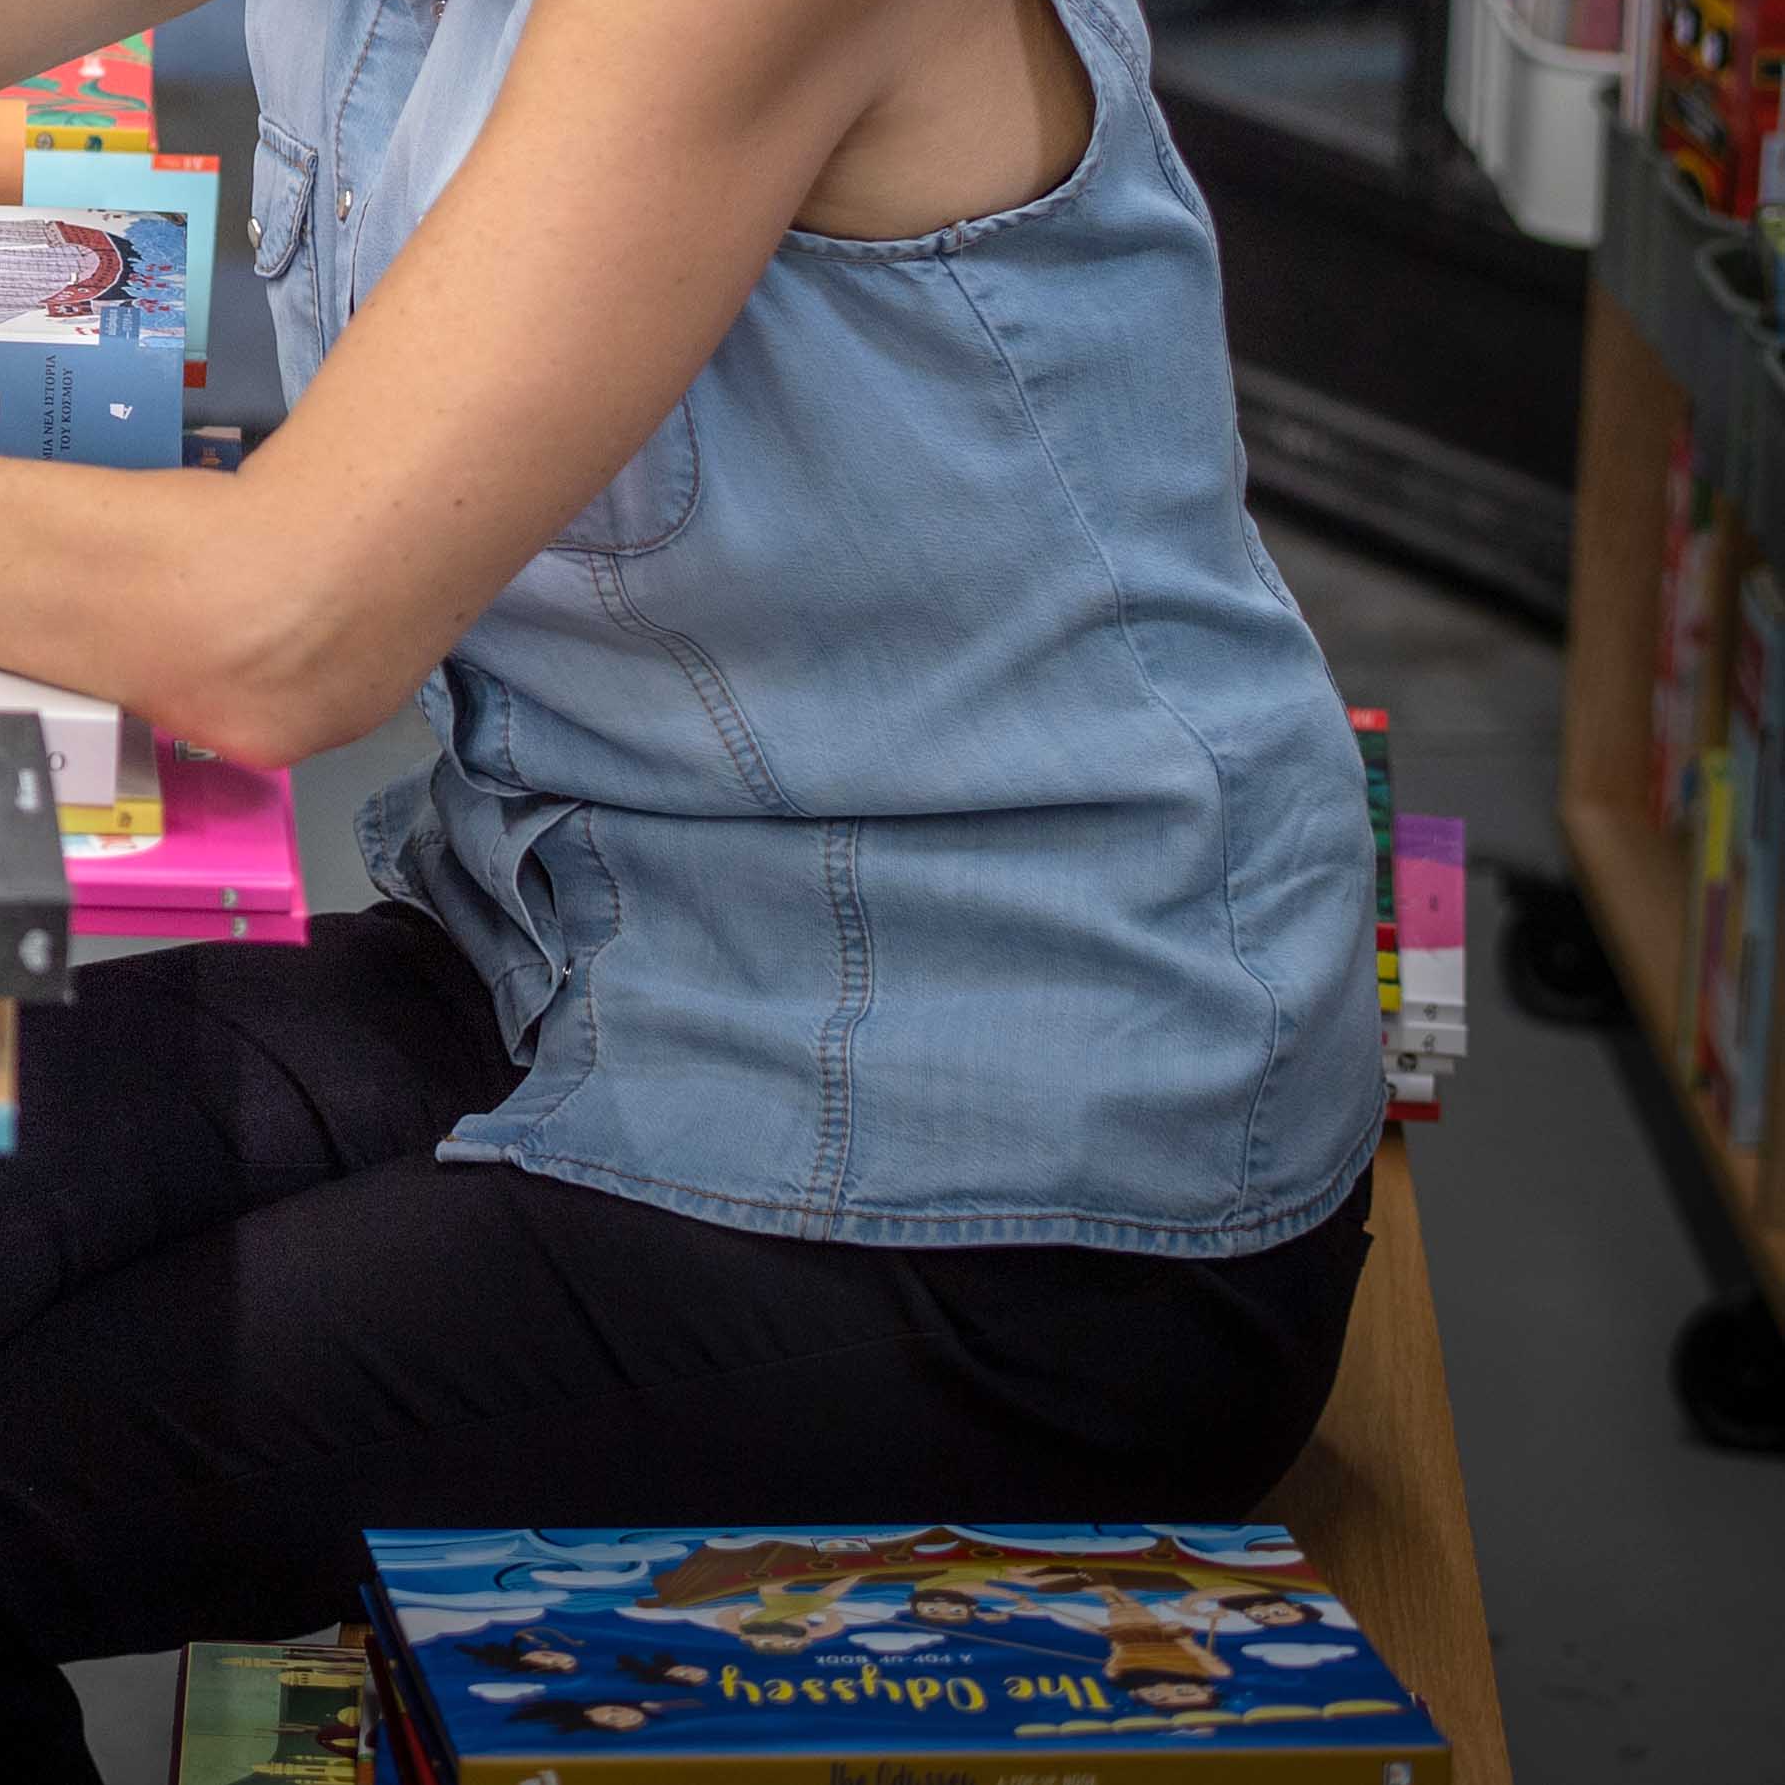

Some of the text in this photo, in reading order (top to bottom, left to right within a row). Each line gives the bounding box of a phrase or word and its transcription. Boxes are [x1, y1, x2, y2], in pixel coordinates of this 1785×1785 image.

[44, 355, 57, 406] ΙΣΤΟΡΙΑ
[43, 410, 55, 435] ΝΕΑ
[60, 368, 76, 452] ΤΟΥ ΚΟΣΜΟΥ
[814, 1654, 869, 1664] BOOK
[718, 1664, 1114, 1714] The Odyssey
